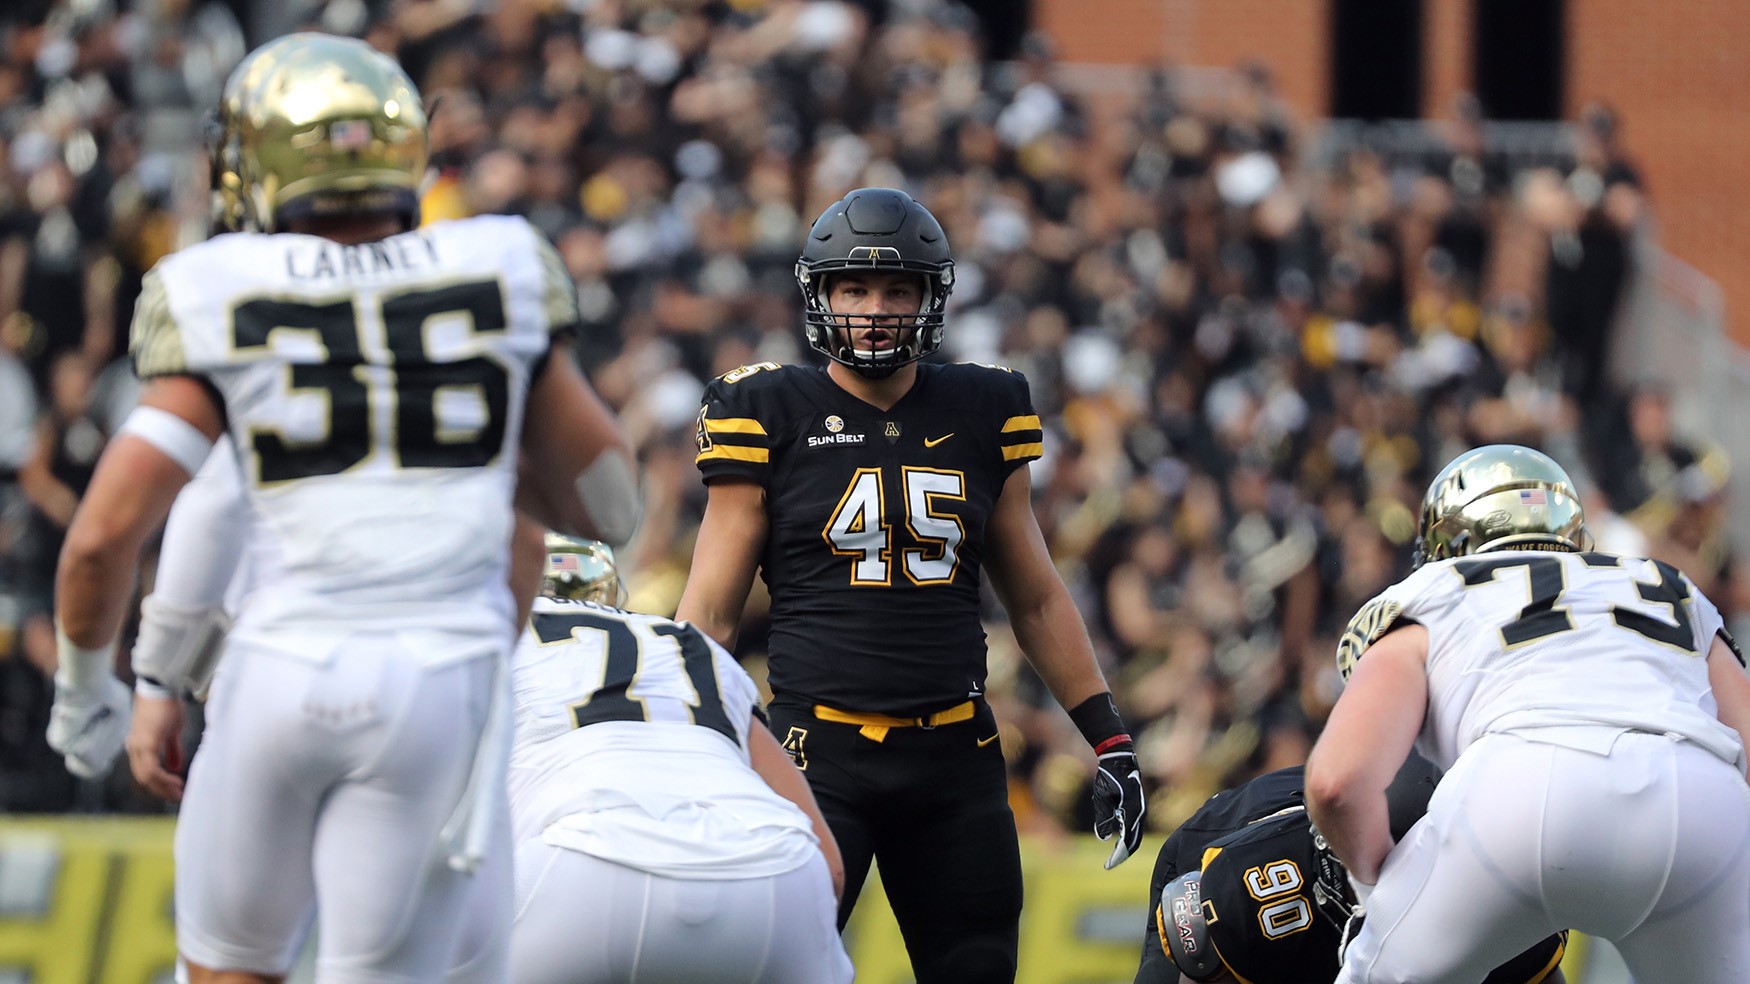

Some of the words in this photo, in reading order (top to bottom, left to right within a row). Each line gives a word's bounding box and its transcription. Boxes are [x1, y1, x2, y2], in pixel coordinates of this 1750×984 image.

[229, 276, 508, 487] 36
[884, 421, 900, 436] A
[822, 465, 966, 586] 45
[1453, 551, 1701, 656] 73
[529, 608, 743, 752] 71
[1243, 858, 1313, 941] 90
